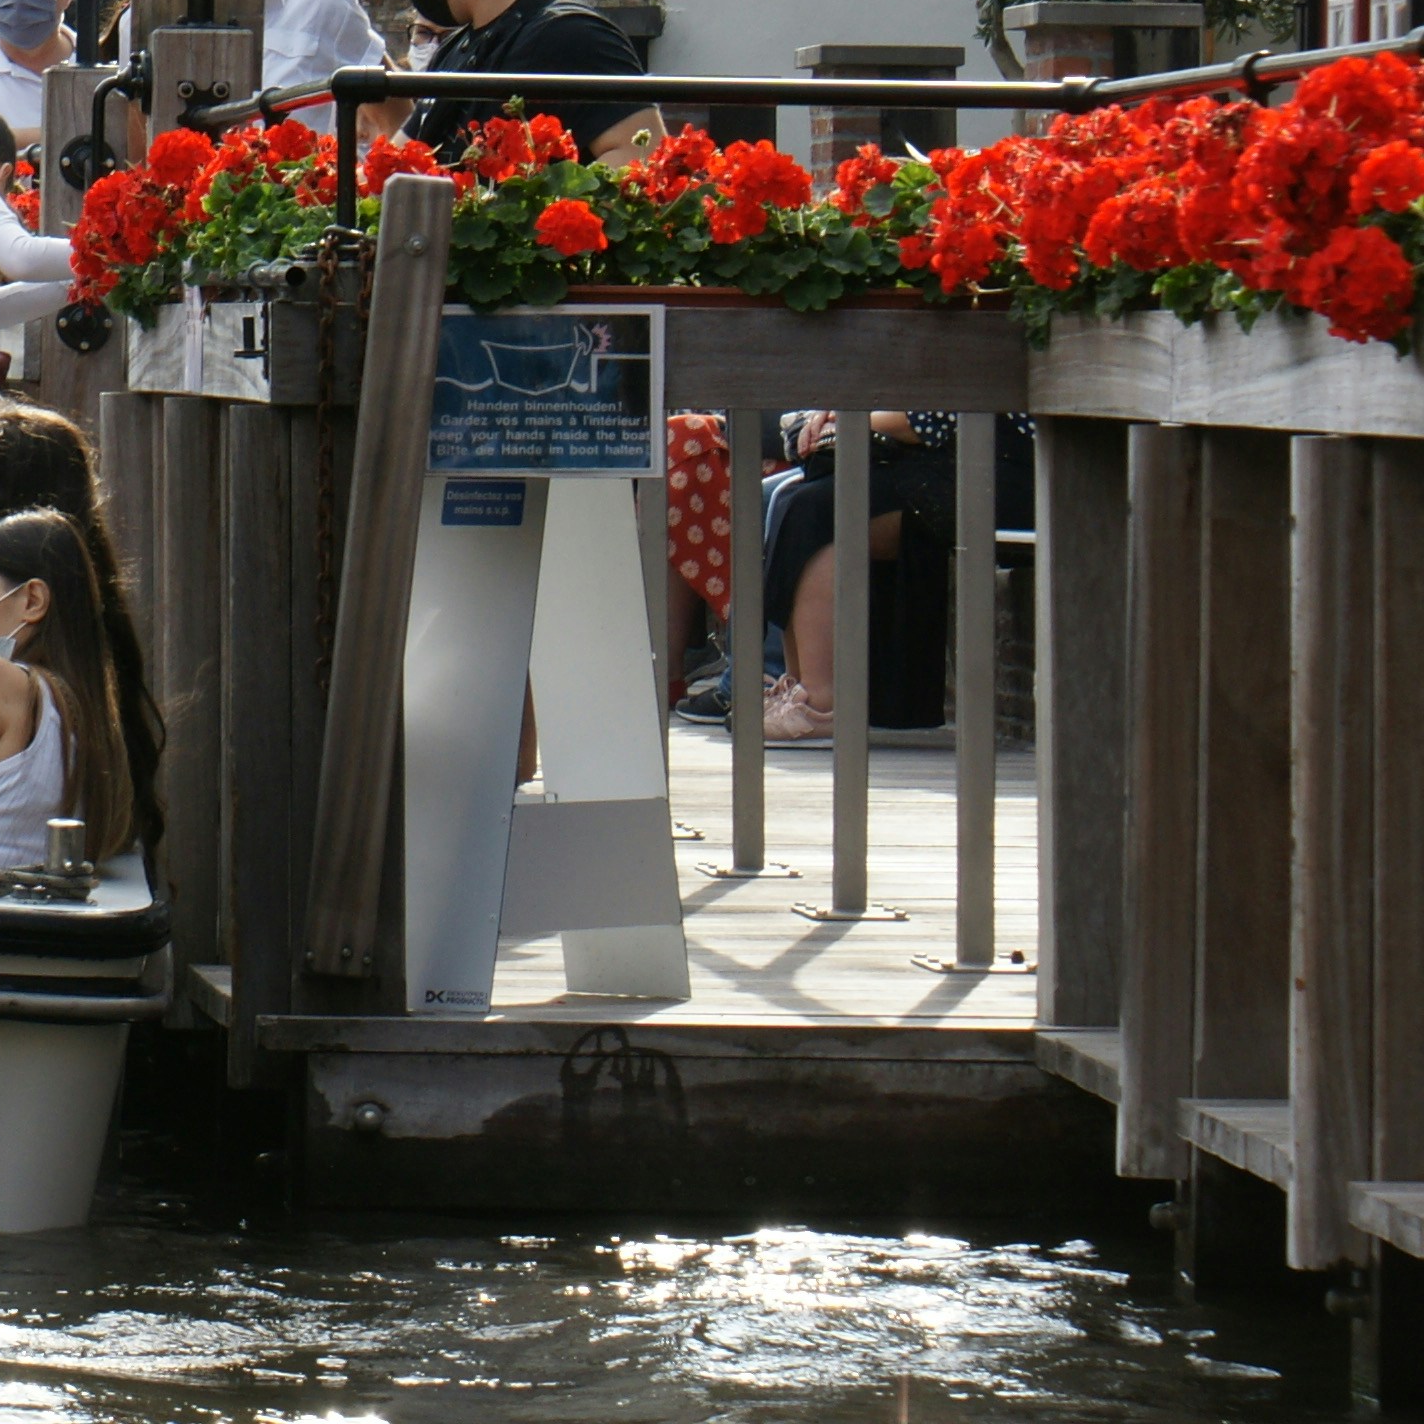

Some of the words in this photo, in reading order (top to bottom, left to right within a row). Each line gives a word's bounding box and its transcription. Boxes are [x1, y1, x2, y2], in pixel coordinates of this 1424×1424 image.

[466, 399, 519, 411] Handen
[440, 414, 489, 426] Gardez
[495, 417, 519, 426] vos
[524, 415, 563, 426] mains
[471, 431, 500, 443] your
[505, 429, 546, 440] hands
[551, 429, 590, 440] inside
[595, 429, 616, 440] the
[436, 444, 469, 456] Bitte
[474, 444, 495, 456] die
